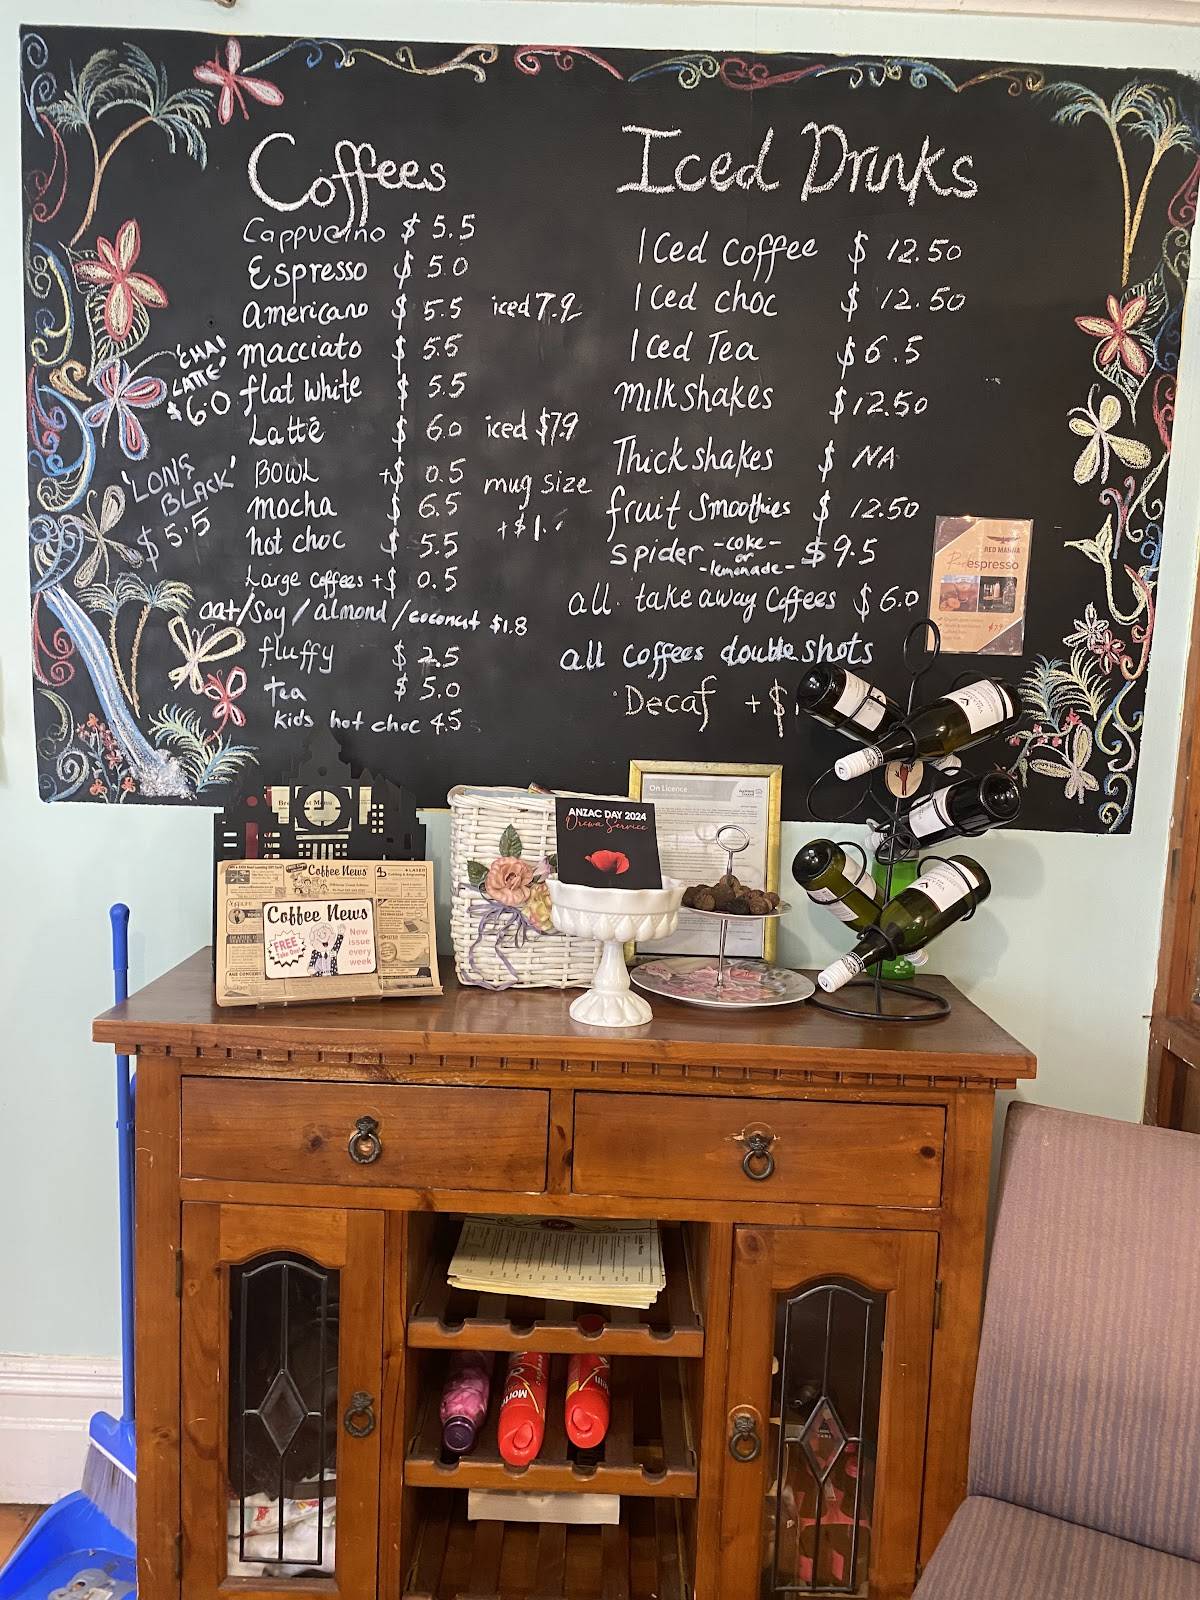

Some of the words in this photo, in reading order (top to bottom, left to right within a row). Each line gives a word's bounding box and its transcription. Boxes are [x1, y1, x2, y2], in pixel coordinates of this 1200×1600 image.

[616, 125, 781, 194] Iced
[800, 121, 979, 207] Drinks
[247, 132, 447, 238] Coffees
[638, 226, 708, 264] Iced
[886, 238, 962, 263] 12.50
[248, 255, 367, 304] Espresso
[491, 293, 531, 318] iced
[634, 282, 698, 311] Iced
[880, 286, 965, 311] 12.50
[630, 328, 693, 362] Iced
[708, 330, 759, 365] Tea
[485, 409, 528, 440] iced
[851, 445, 896, 470] NA
[484, 474, 532, 510] mug
[540, 470, 593, 494] size
[850, 496, 920, 520] 12.50
[245, 525, 284, 557] hot
[292, 525, 346, 553] choc
[609, 538, 704, 572] spider
[735, 552, 755, 563] or
[967, 559, 1019, 571] espresso
[245, 564, 301, 596] Large
[559, 640, 605, 671] all
[801, 633, 874, 664] shots
[625, 674, 718, 733] Decaf
[330, 710, 364, 731] hot
[370, 713, 421, 734] choc
[649, 784, 662, 793] On
[661, 784, 688, 793] Licence
[568, 807, 603, 818] ANZAC
[604, 809, 623, 820] DAY
[624, 811, 647, 822] 2024
[605, 816, 648, 834] Service
[308, 863, 340, 878] Coffee
[342, 864, 367, 877] News
[267, 904, 321, 926] Coffee
[327, 903, 369, 922] News
[348, 938, 370, 946] issue
[349, 927, 368, 936] New
[273, 936, 299, 953] FREE
[276, 950, 289, 960] Take
[349, 948, 372, 959] every
[349, 957, 372, 967] week
